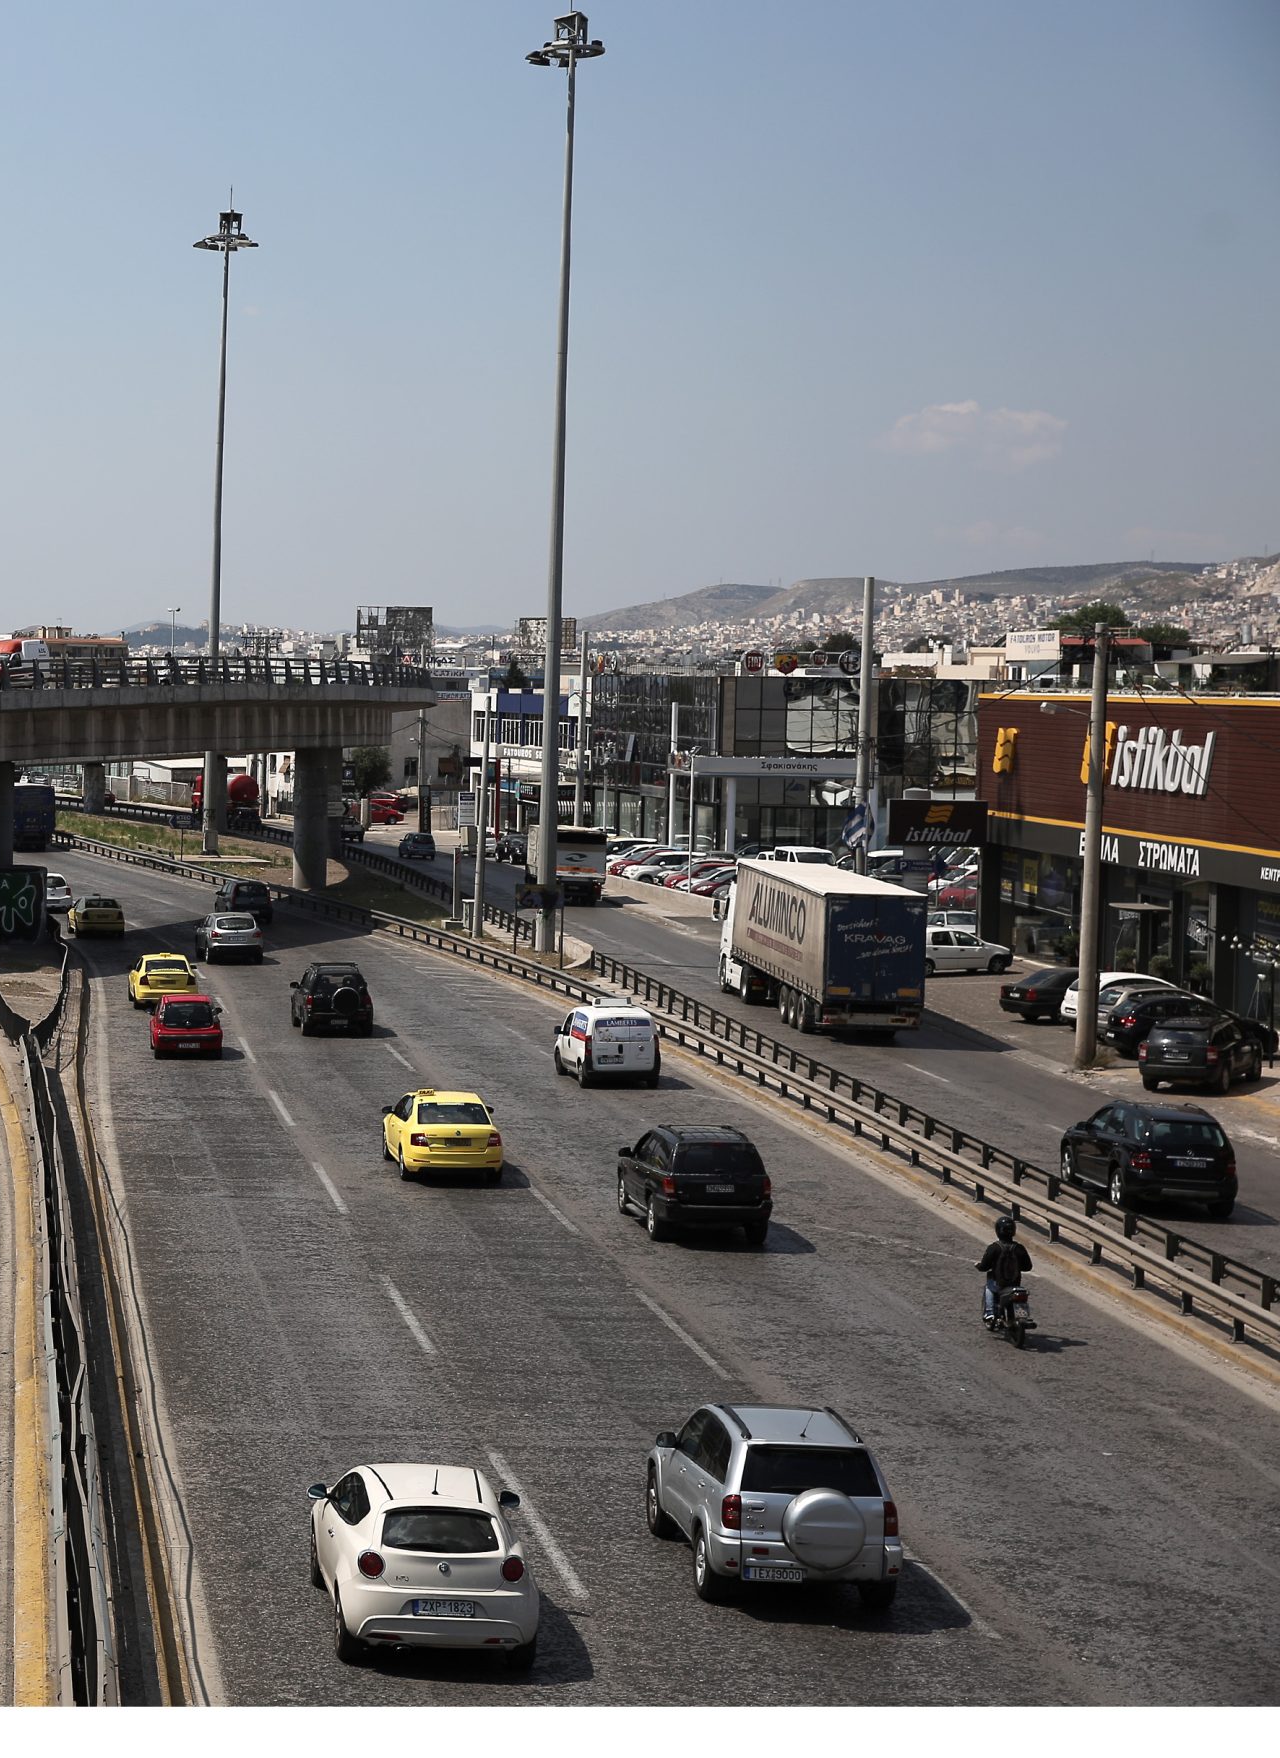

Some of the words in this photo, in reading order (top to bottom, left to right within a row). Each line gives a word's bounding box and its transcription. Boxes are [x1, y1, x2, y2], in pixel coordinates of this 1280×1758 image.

[761, 761, 818, 772] Σφακιανάκης
[1110, 725, 1216, 796] istikbal
[905, 827, 972, 842] istikbal
[1138, 841, 1200, 877] ΣΤΡΩΜΑΤΑ
[749, 882, 806, 945] ALUMINCO
[844, 933, 906, 945] KRAVAG
